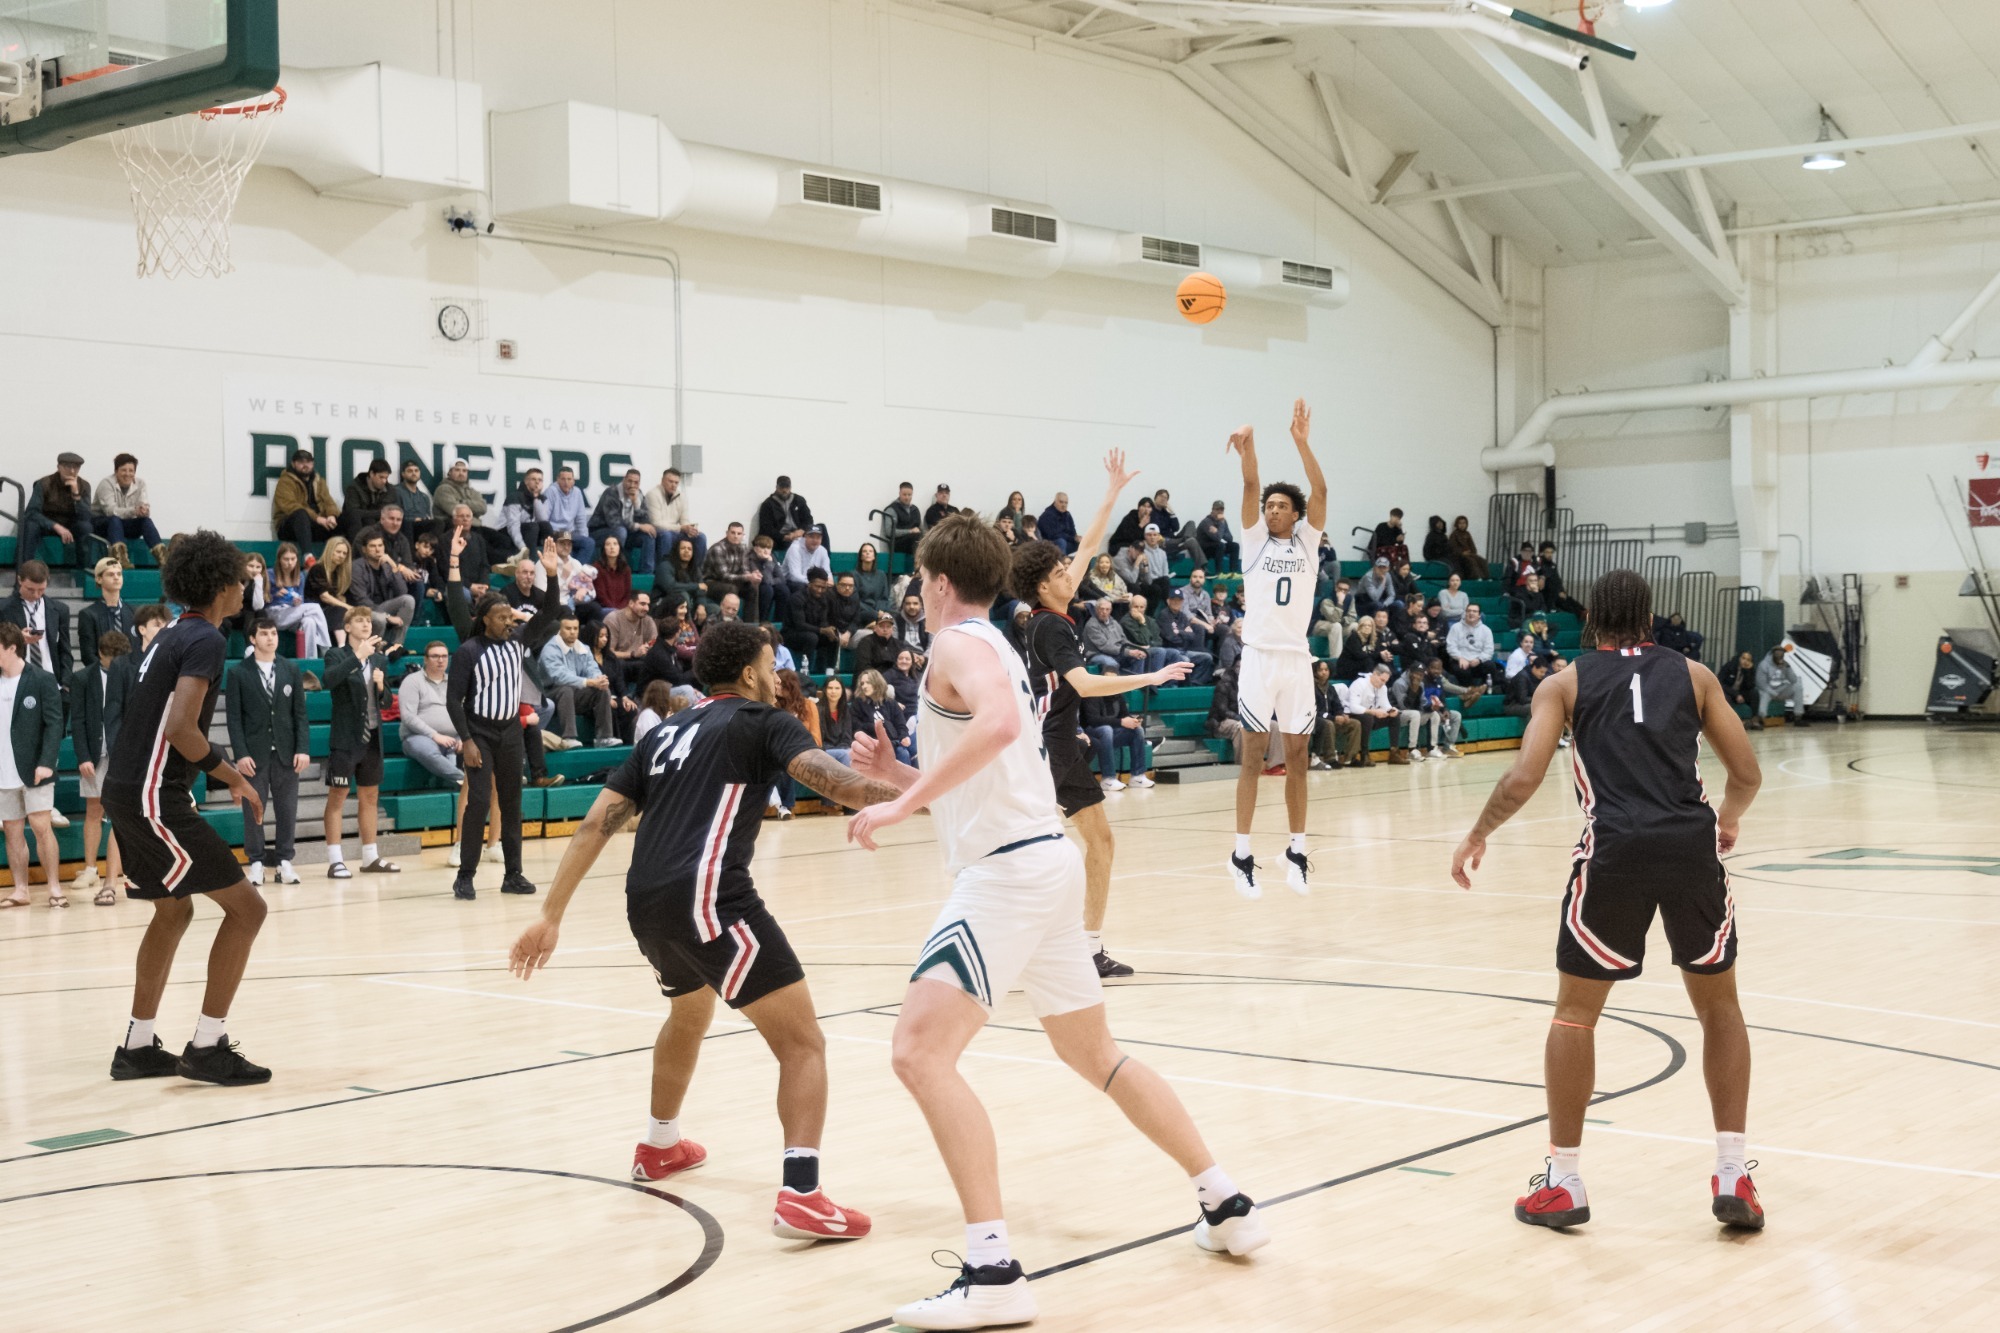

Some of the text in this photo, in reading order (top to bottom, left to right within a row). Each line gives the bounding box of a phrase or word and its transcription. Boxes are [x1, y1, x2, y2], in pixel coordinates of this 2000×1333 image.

[248, 398, 636, 436] WESTERN RESERVE ACADEMY
[1262, 556, 1306, 573] RESERVE
[1276, 577, 1291, 606] 0
[139, 643, 159, 682] 4
[1629, 672, 1643, 723] 1
[649, 723, 701, 775] 24
